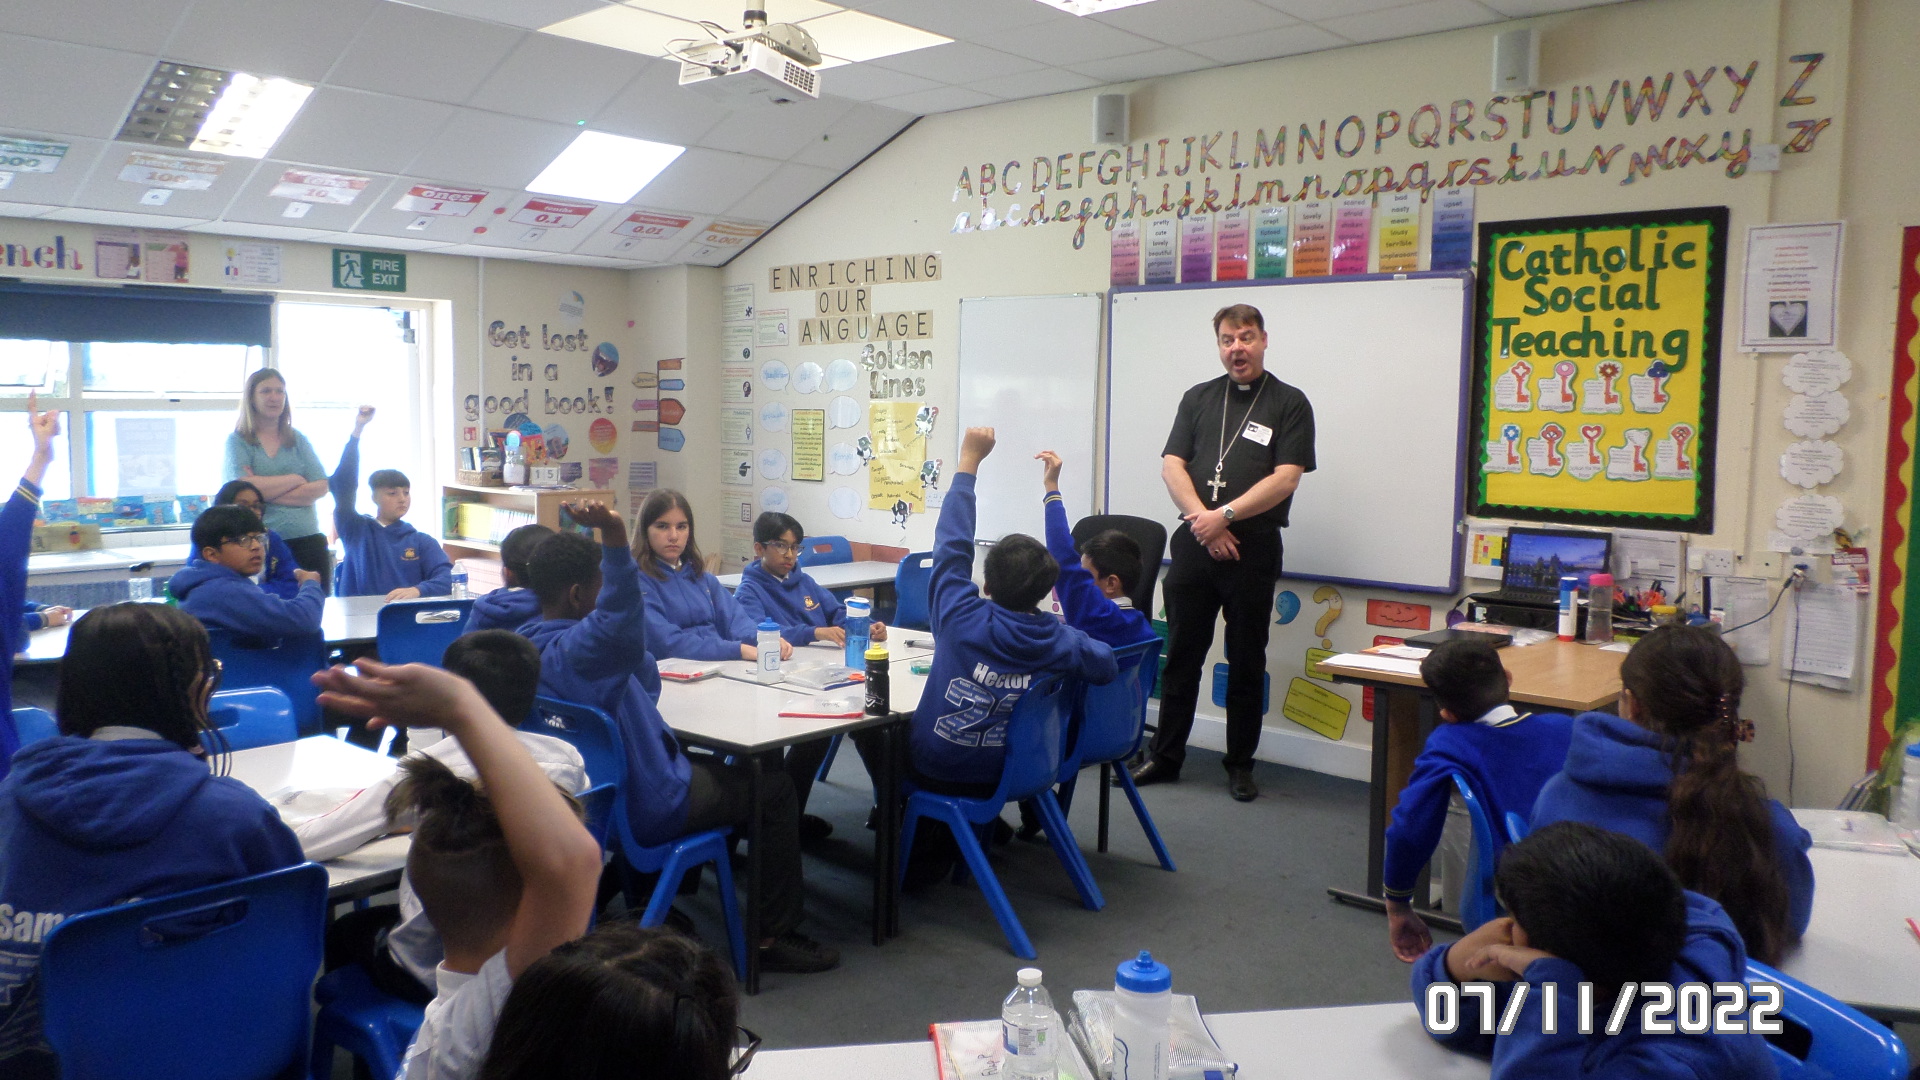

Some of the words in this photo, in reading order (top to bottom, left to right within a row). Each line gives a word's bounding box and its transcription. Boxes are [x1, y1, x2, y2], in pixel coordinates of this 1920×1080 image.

[304, 188, 329, 198] 10
[421, 189, 474, 203] ones
[429, 202, 444, 211] 1
[534, 214, 563, 224] 0.1
[543, 205, 574, 214] tenths
[632, 225, 665, 235] 0.01
[705, 235, 746, 245] 0.001
[372, 259, 400, 272] FIRE
[1499, 228, 1697, 281] Catholic
[372, 273, 400, 286] EXIT
[773, 254, 937, 290] ENRICHING
[819, 289, 867, 314] OUR
[1523, 268, 1661, 316] Social
[488, 320, 530, 349] Get
[542, 324, 589, 351] lost
[802, 312, 928, 343] ANGUAGE
[860, 341, 933, 372] Golden
[1493, 316, 1689, 373] Teaching
[511, 355, 533, 381] in
[544, 363, 558, 381] a
[869, 371, 926, 399] Lines
[464, 389, 529, 421] good
[544, 386, 615, 415] book!
[972, 661, 1032, 690] Hector
